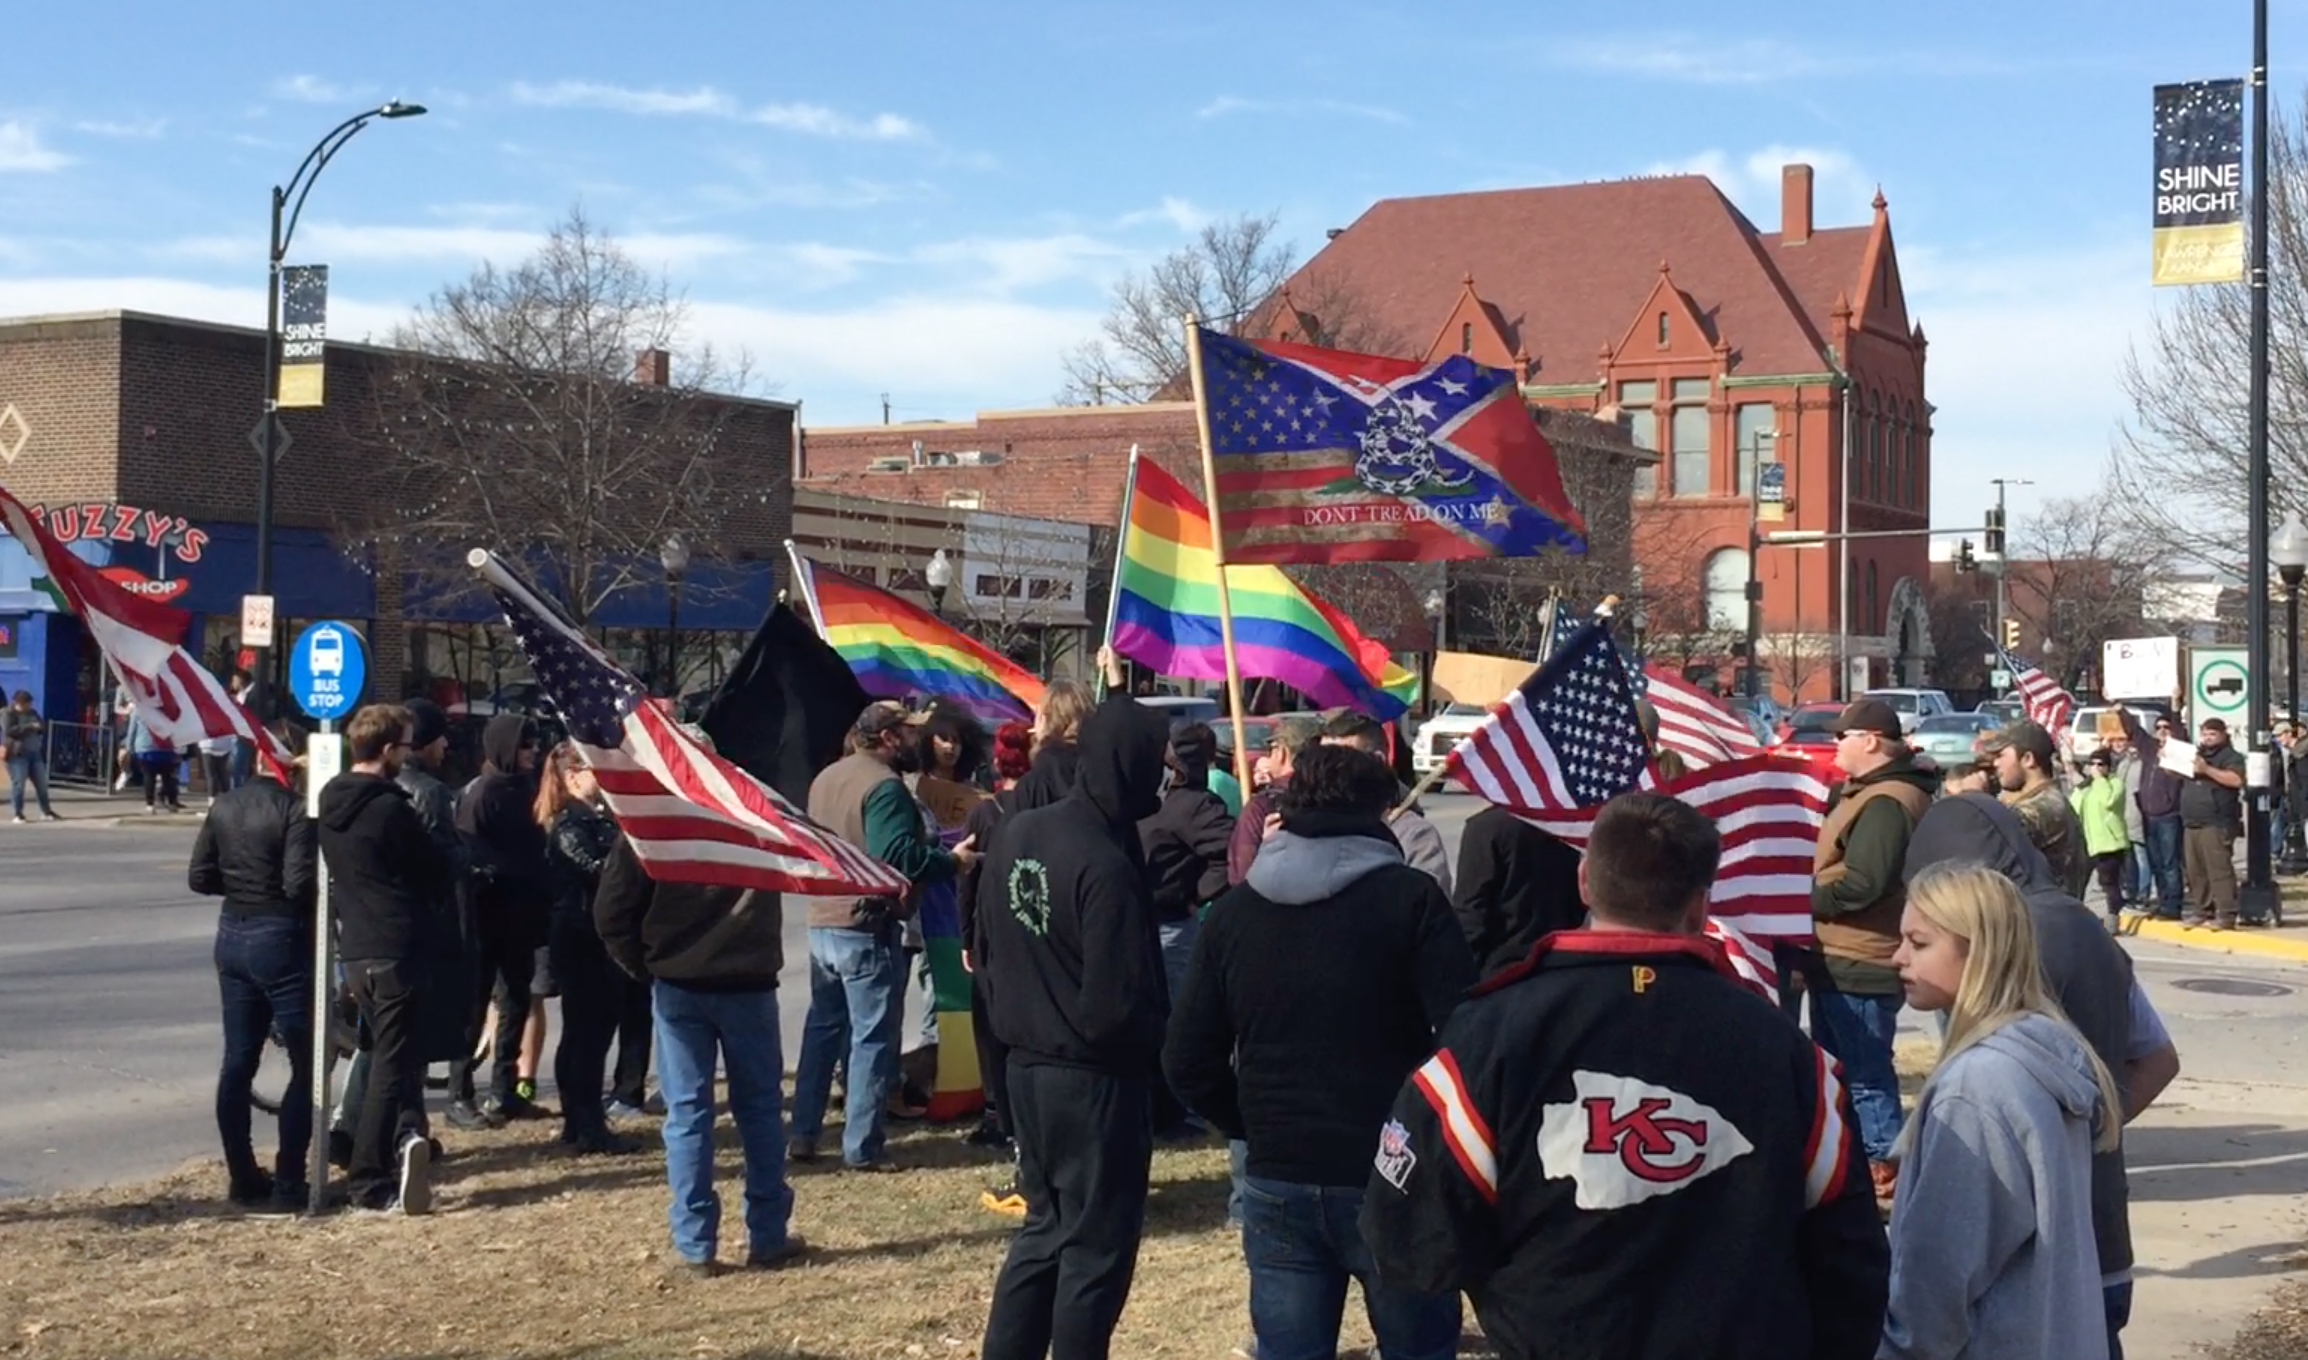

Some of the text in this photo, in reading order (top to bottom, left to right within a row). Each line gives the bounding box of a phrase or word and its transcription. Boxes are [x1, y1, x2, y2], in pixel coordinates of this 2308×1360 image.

[2158, 163, 2241, 191] SHINE
[2157, 191, 2239, 215] BRIGHT
[284, 322, 326, 341] SHINE
[284, 341, 324, 358] BRIGHT
[1303, 502, 1498, 525] DONT TREAD ON ME
[312, 678, 341, 692] BUS
[308, 692, 344, 708] STOP
[1581, 1096, 1708, 1183] KC
